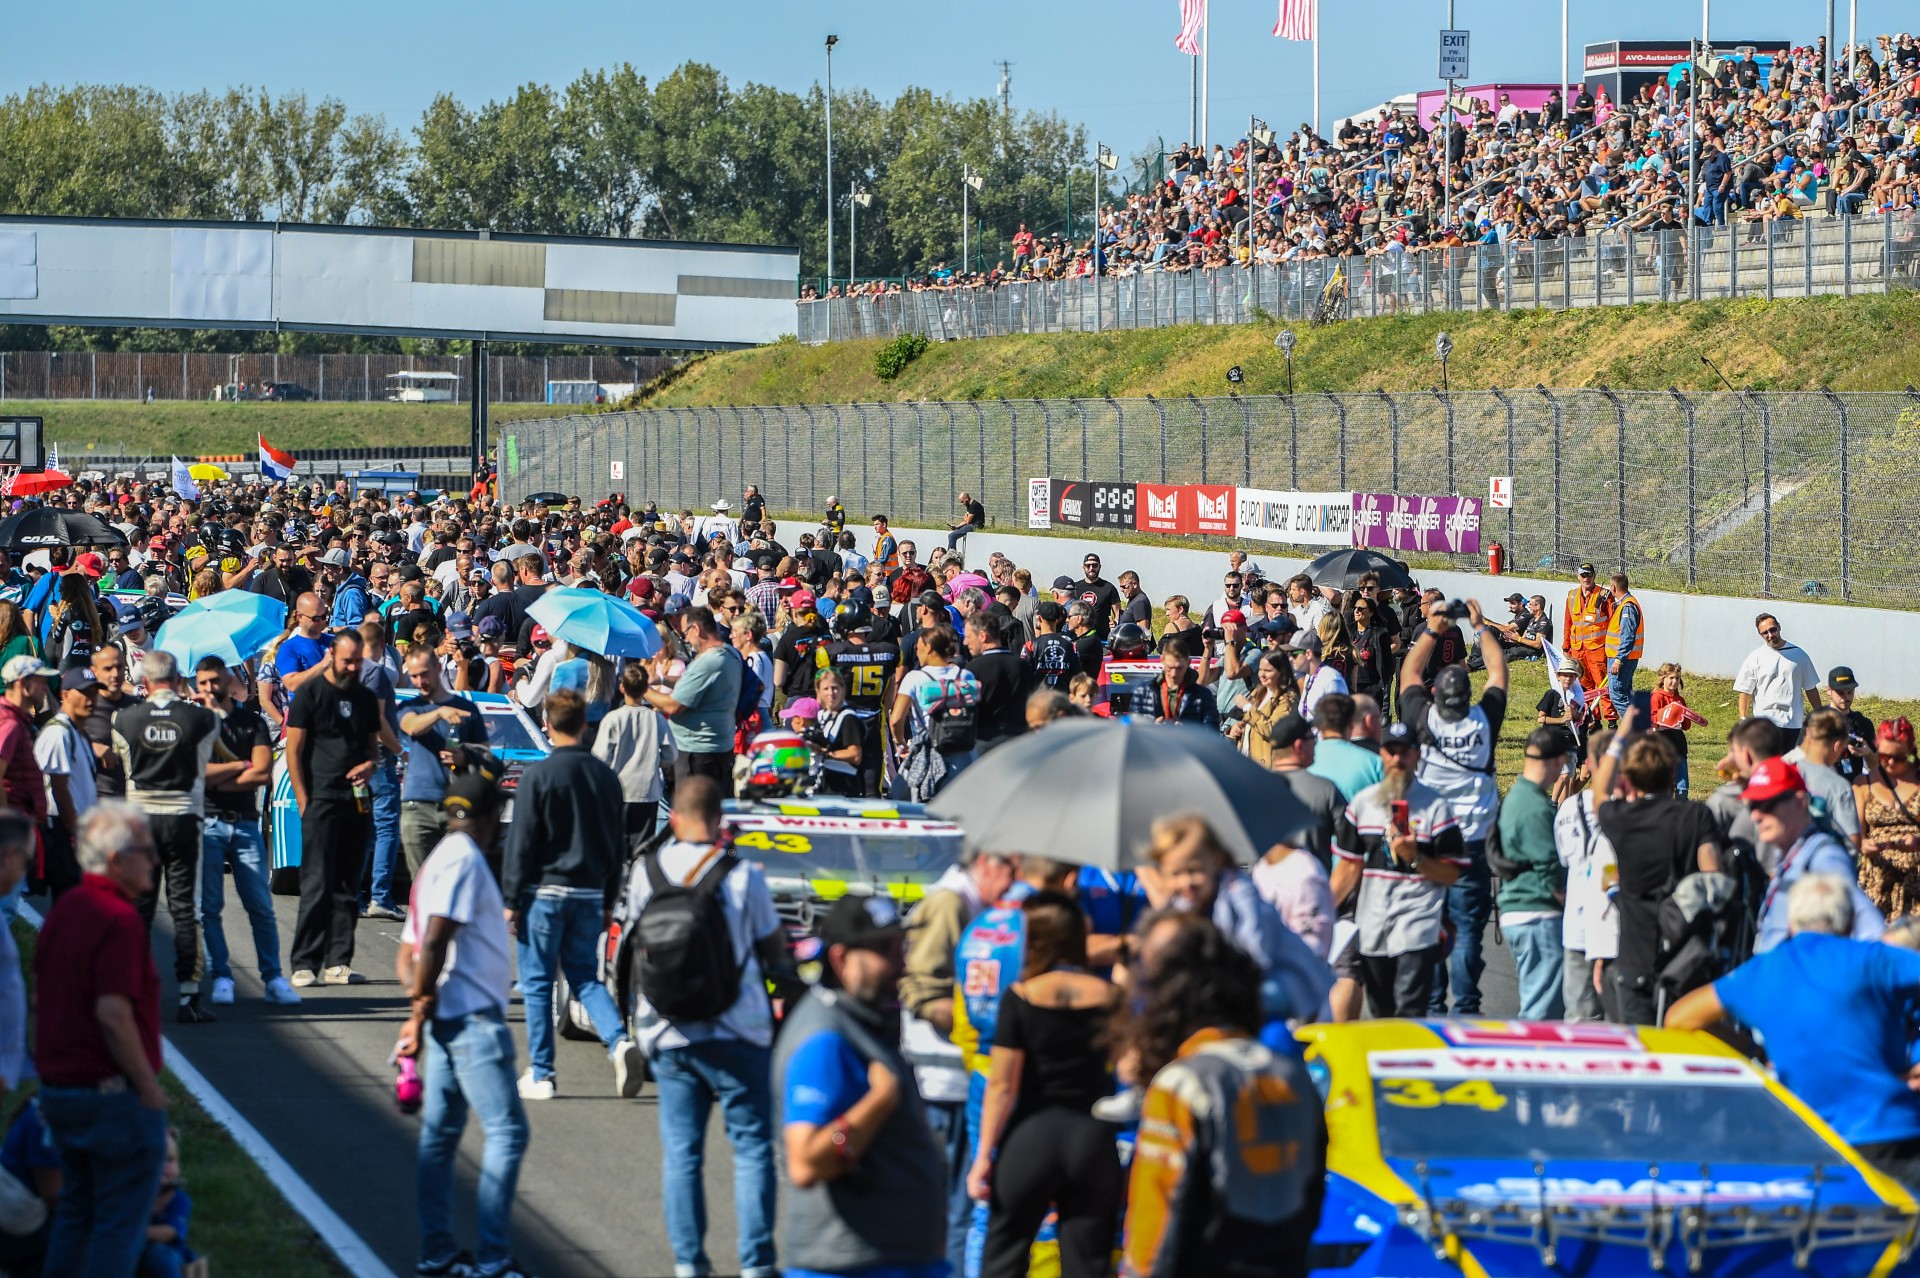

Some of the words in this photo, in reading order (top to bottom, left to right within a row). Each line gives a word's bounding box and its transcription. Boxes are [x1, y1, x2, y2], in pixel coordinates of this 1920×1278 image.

[1443, 36, 1467, 46] EXIT
[1147, 489, 1178, 519] WHELEN
[1197, 490, 1229, 520] WHELEN
[1240, 500, 1260, 527] EURO
[1266, 502, 1289, 531] NASCAR
[1296, 505, 1317, 532] EURO
[1324, 505, 1350, 532] NASCAR
[837, 654, 871, 662] MOUNTAIN
[851, 665, 883, 696] 15
[1110, 673, 1126, 684] 8
[1436, 734, 1483, 749] MEDIA
[734, 831, 813, 854] 43
[1380, 1078, 1508, 1111] 34
